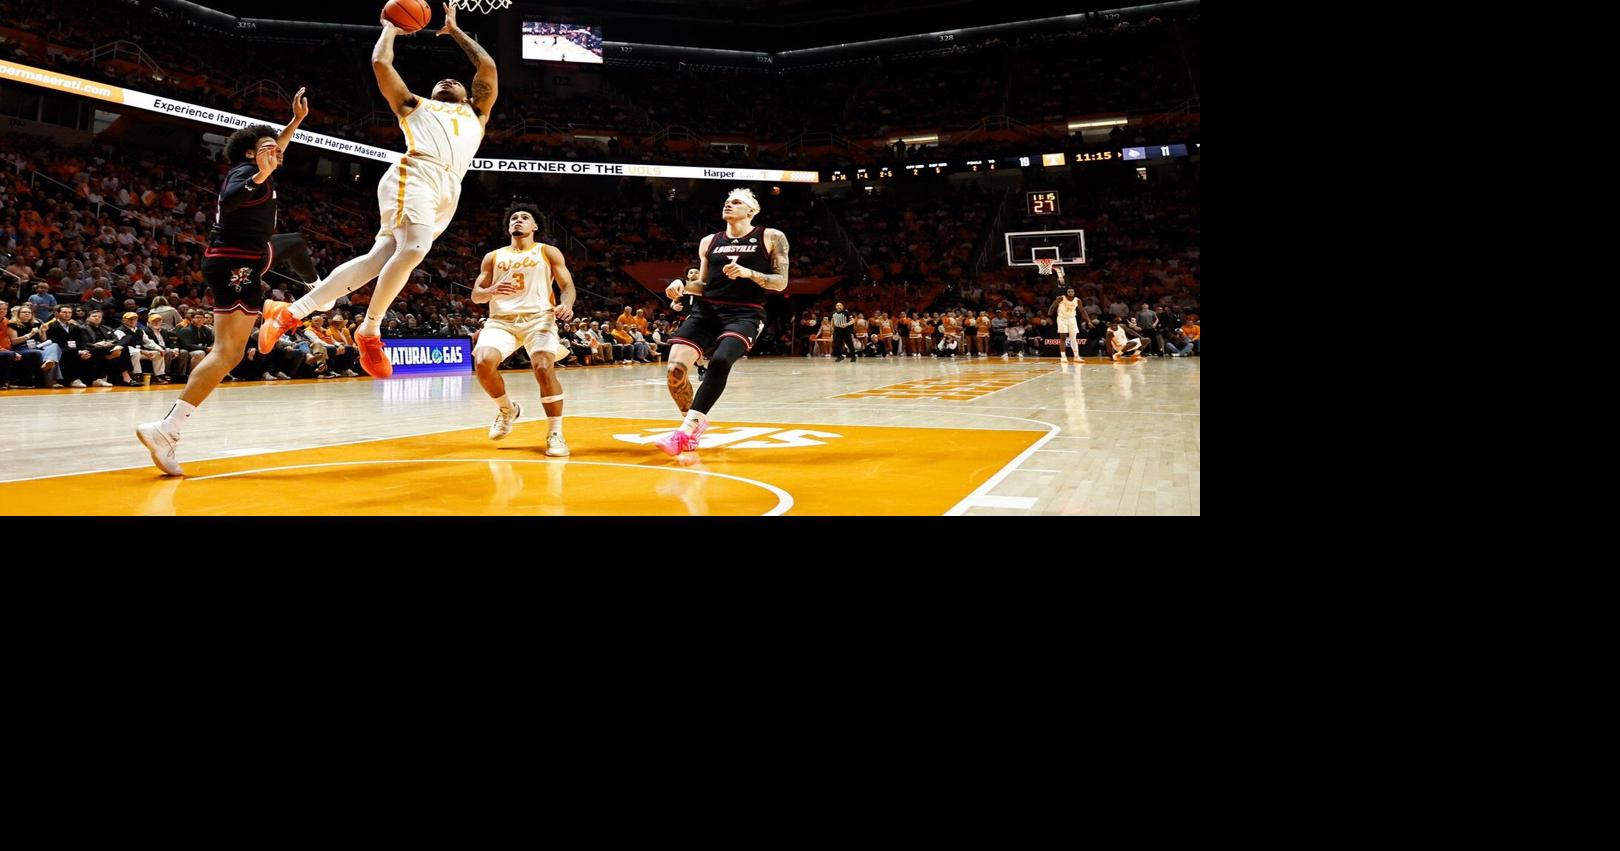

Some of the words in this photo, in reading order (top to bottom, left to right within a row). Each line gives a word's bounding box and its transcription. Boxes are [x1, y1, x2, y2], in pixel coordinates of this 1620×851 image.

[153, 98, 215, 120] Experience
[216, 112, 248, 128] Italian
[314, 135, 324, 144] at
[325, 138, 353, 152] Harper
[354, 143, 387, 159] Maserati
[451, 118, 459, 136] 1
[1075, 151, 1112, 162] 11:15
[1160, 145, 1170, 156] 11
[468, 159, 494, 169] UD
[498, 160, 566, 172] PARTNER
[571, 163, 591, 173] OF
[596, 164, 623, 174] THE
[627, 166, 662, 175] VOLS
[1019, 156, 1030, 167] 19
[704, 169, 735, 179] Harper
[1033, 192, 1055, 201] 11:15
[1034, 200, 1054, 213] 27
[713, 245, 758, 254] LOUISVILLE
[498, 257, 539, 271] Vols
[512, 273, 525, 290] 3
[383, 346, 433, 365] NATURAL
[442, 346, 463, 364] GAS
